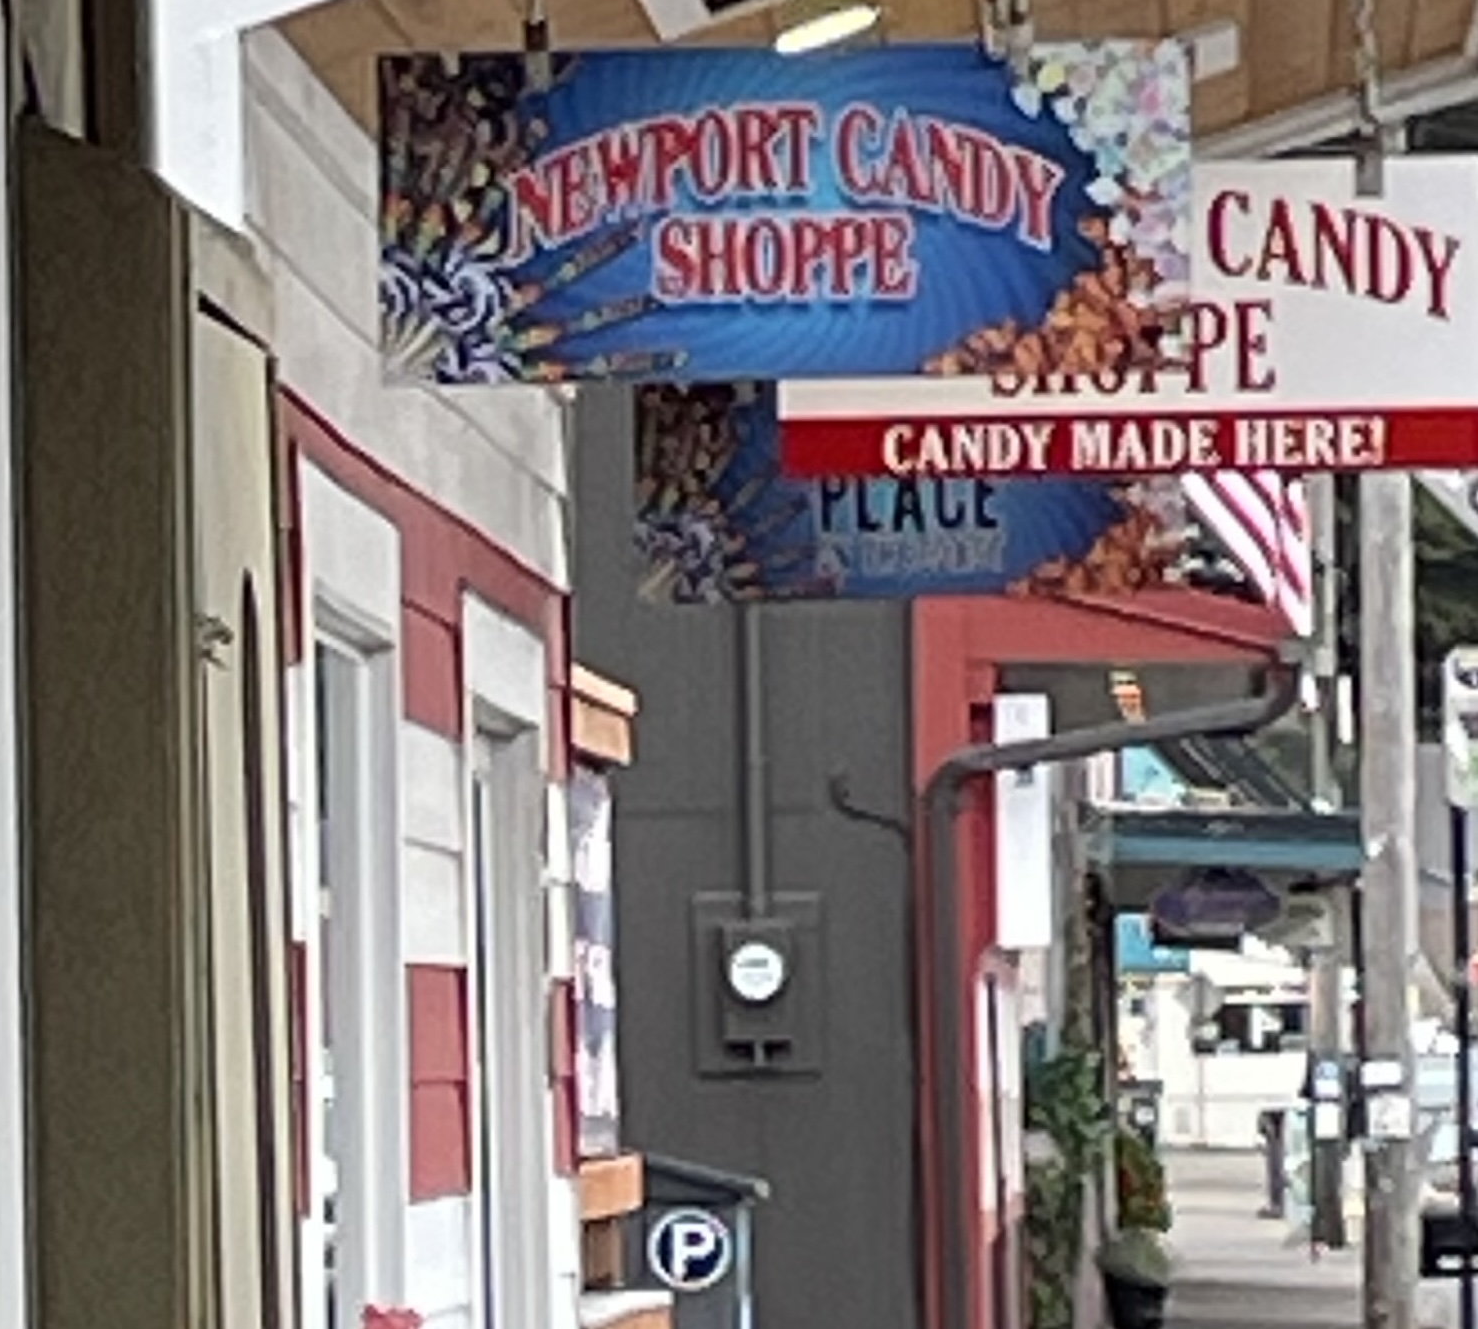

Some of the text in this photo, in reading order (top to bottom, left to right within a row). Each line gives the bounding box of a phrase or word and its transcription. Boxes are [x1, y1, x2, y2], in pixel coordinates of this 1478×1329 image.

[502, 103, 1062, 262] NEWPORT CANDY
[653, 213, 916, 300] SHOPPE
[1206, 189, 1460, 320] CANDY
[882, 414, 1385, 473] CANDY MADE HERE!
[821, 475, 999, 532] PLACE
[673, 1223, 715, 1279] P
